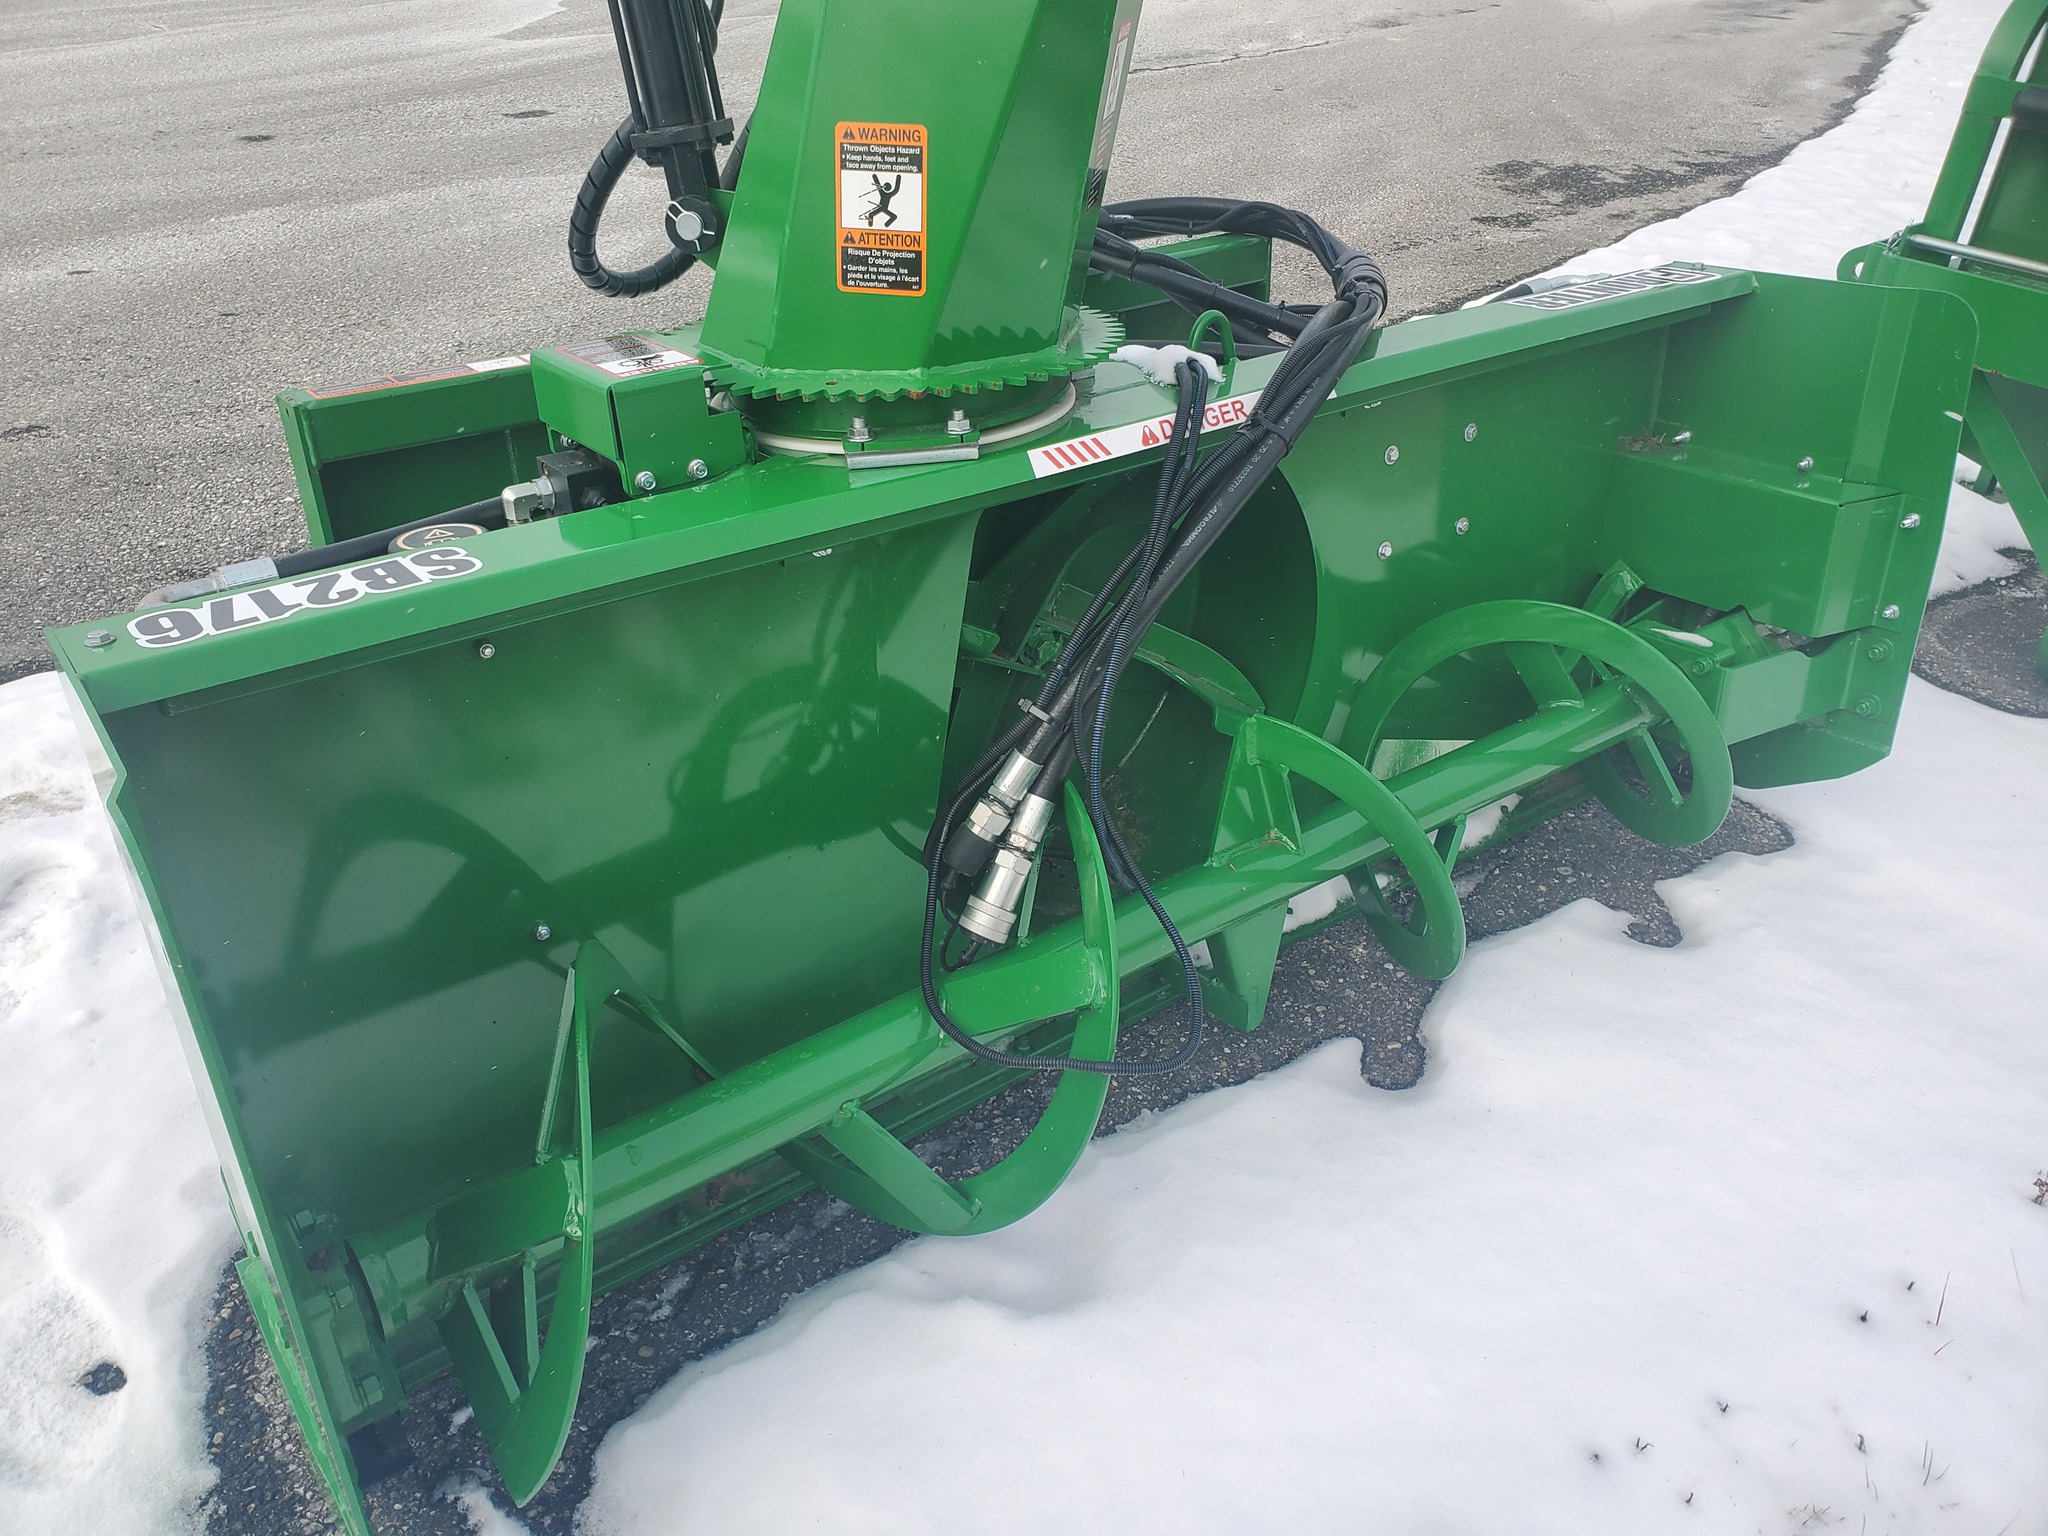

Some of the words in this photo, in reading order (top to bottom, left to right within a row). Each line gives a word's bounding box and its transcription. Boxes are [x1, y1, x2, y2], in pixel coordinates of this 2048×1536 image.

[858, 128, 921, 142] WARNING
[843, 144, 868, 152] Thrown
[870, 145, 895, 154] Objects
[858, 232, 921, 247] ATTENTION
[882, 250, 915, 259] Projection
[868, 258, 895, 266] D'objets
[856, 280, 888, 288] l'ouverture.
[1159, 399, 1248, 440] DGER
[1180, 505, 1220, 549] ALFAGOMMA
[129, 547, 481, 647] SB2176
